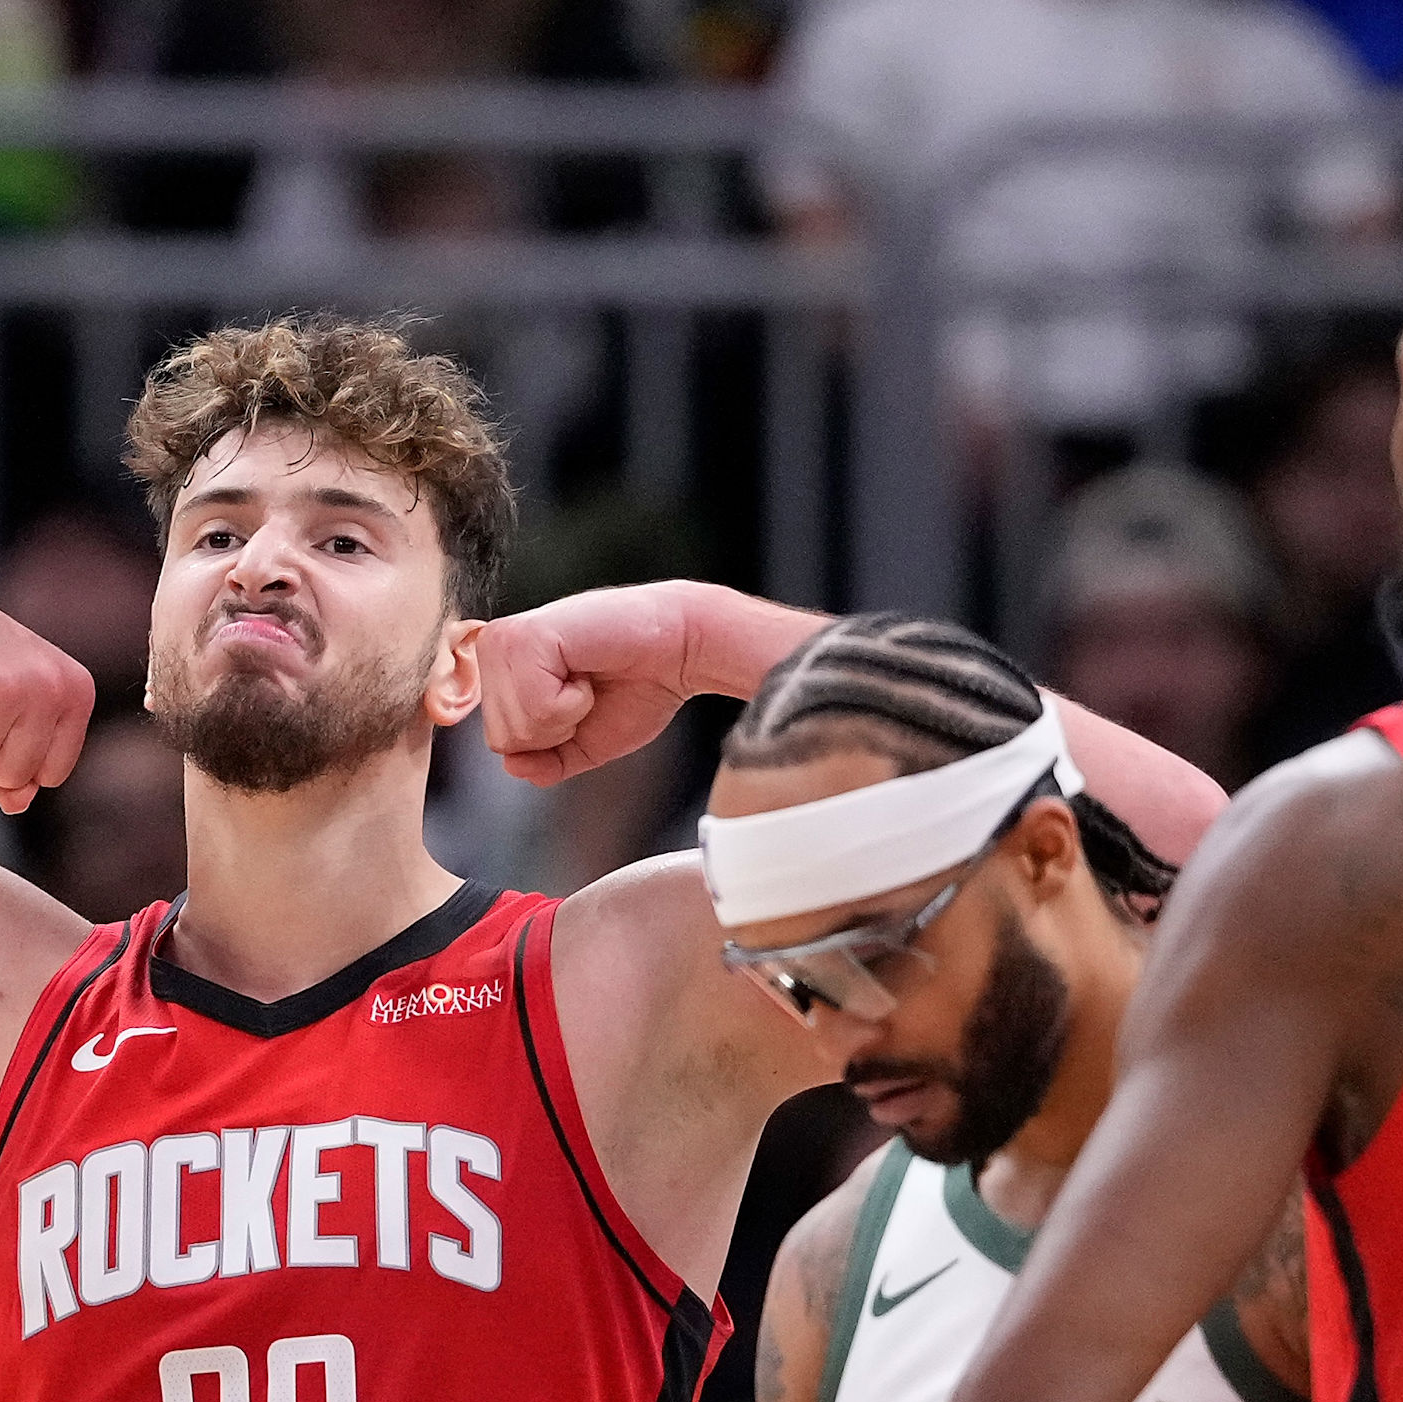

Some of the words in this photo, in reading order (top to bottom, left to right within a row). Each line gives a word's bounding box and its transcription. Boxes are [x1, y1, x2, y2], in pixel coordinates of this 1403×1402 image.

[370, 990, 503, 1024] HERMANN
[372, 979, 504, 1013] MEMORIAL
[17, 1115, 502, 1341] ROCKETS
